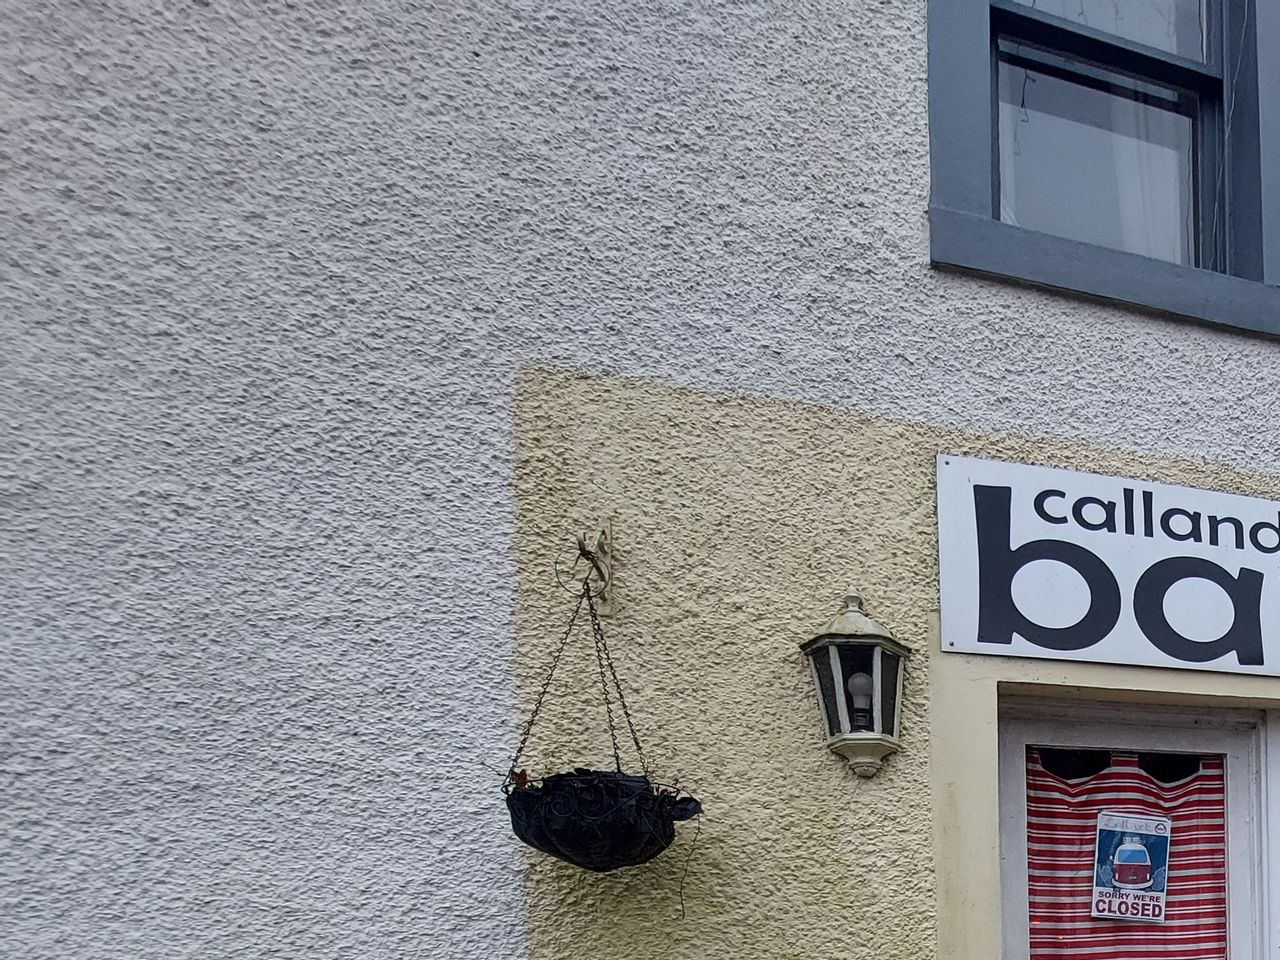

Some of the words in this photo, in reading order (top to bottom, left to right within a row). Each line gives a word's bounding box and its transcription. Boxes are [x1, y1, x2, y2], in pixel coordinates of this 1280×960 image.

[1099, 891, 1130, 900] SORRY
[1133, 894, 1161, 903] WE'RE
[1095, 899, 1162, 917] CLOSED
